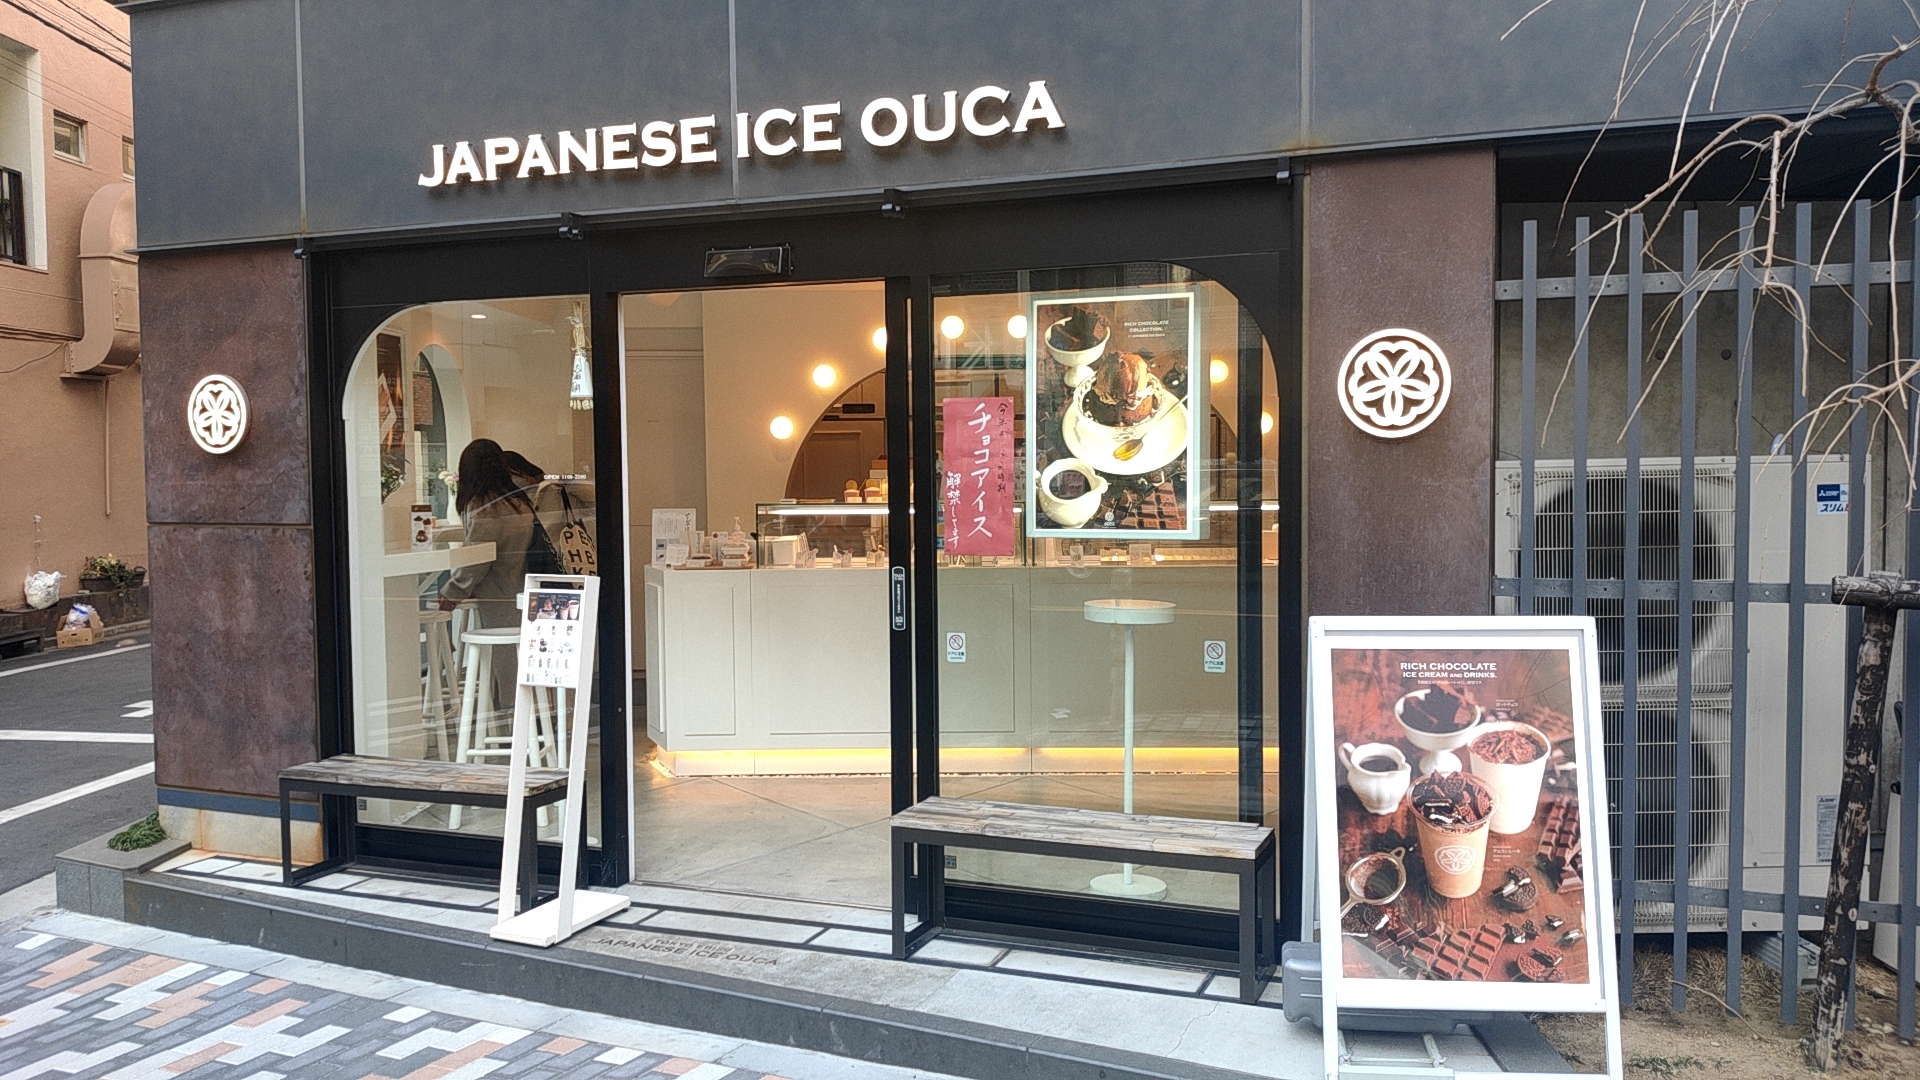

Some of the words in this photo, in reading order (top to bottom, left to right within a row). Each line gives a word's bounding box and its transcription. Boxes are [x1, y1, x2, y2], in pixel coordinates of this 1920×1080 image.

[418, 114, 718, 187] JAPANESE
[735, 101, 842, 159] ICE
[860, 80, 1066, 147] OUCA
[967, 402, 993, 538] チョコアイス
[1400, 662, 1427, 670] RICH
[1429, 662, 1498, 671] CHOCOLATE
[1464, 671, 1498, 679] DRINKS.
[593, 938, 684, 956] JAPANESE
[689, 949, 724, 960] ICE
[725, 953, 778, 966] OUCA
[655, 939, 693, 948] TOKYO
